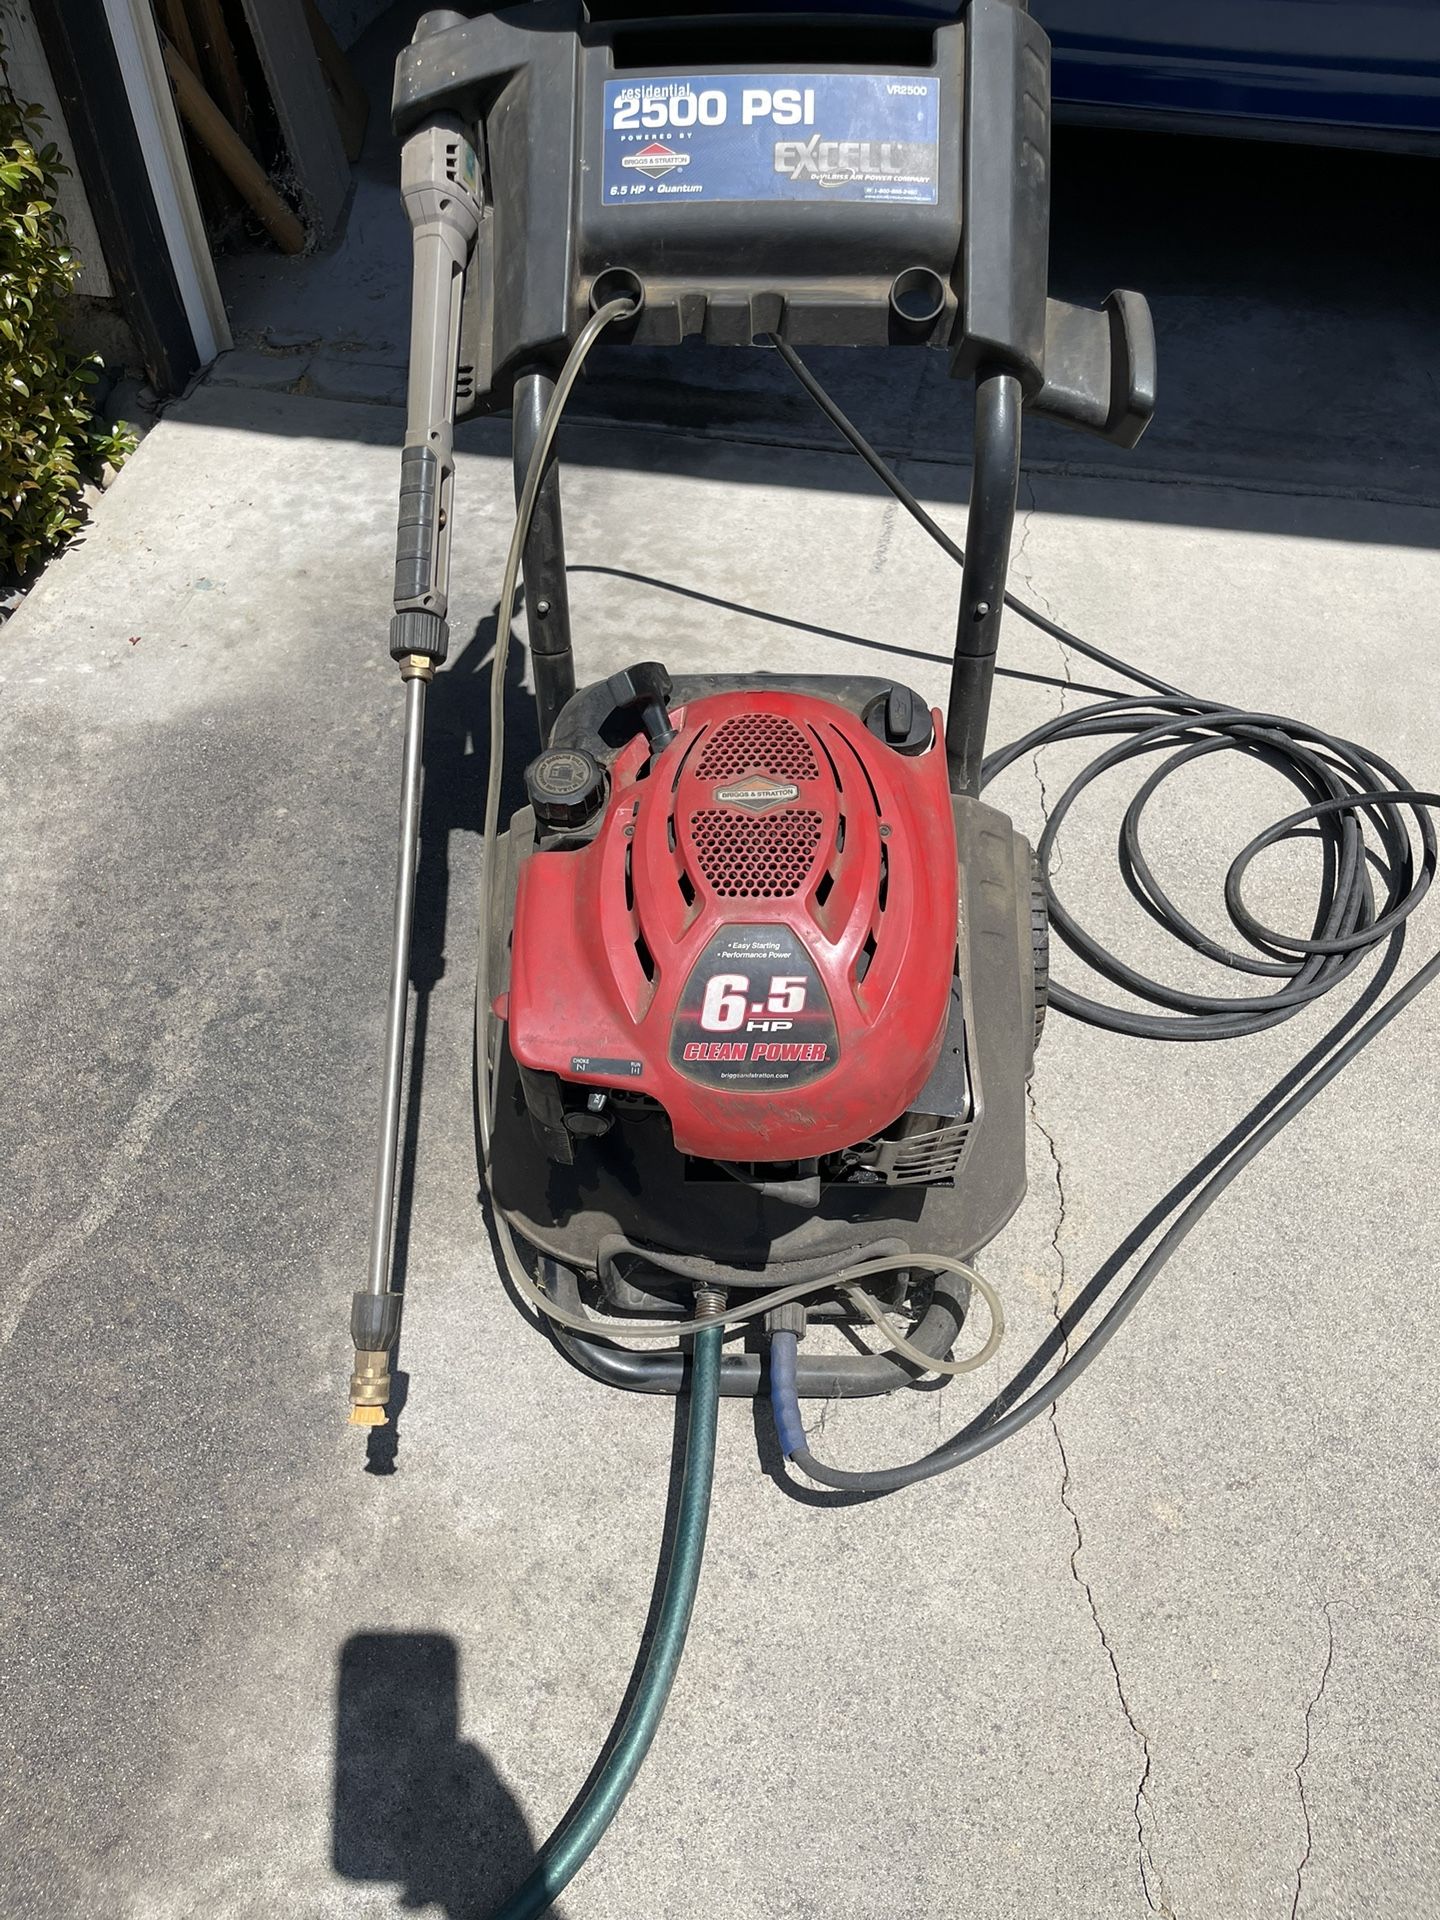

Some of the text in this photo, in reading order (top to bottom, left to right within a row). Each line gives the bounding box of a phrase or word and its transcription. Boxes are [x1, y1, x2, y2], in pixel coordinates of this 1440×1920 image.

[621, 83, 690, 99] residential
[887, 85, 927, 96] VR2500
[613, 89, 815, 130] 2500 PSI
[620, 133, 672, 141] POWERED
[655, 156, 688, 165] STRATTON
[864, 174, 892, 182] POWER
[893, 175, 930, 184] COMPANY
[610, 184, 703, 196] 6.5 HP Quantum
[757, 789, 793, 798] STRATTON
[732, 942, 780, 951] Easy Starting
[721, 951, 791, 959] Performance Power
[700, 974, 808, 1031] 6.5
[746, 1021, 793, 1032] HP
[683, 1042, 828, 1062] CLEAN POWER
